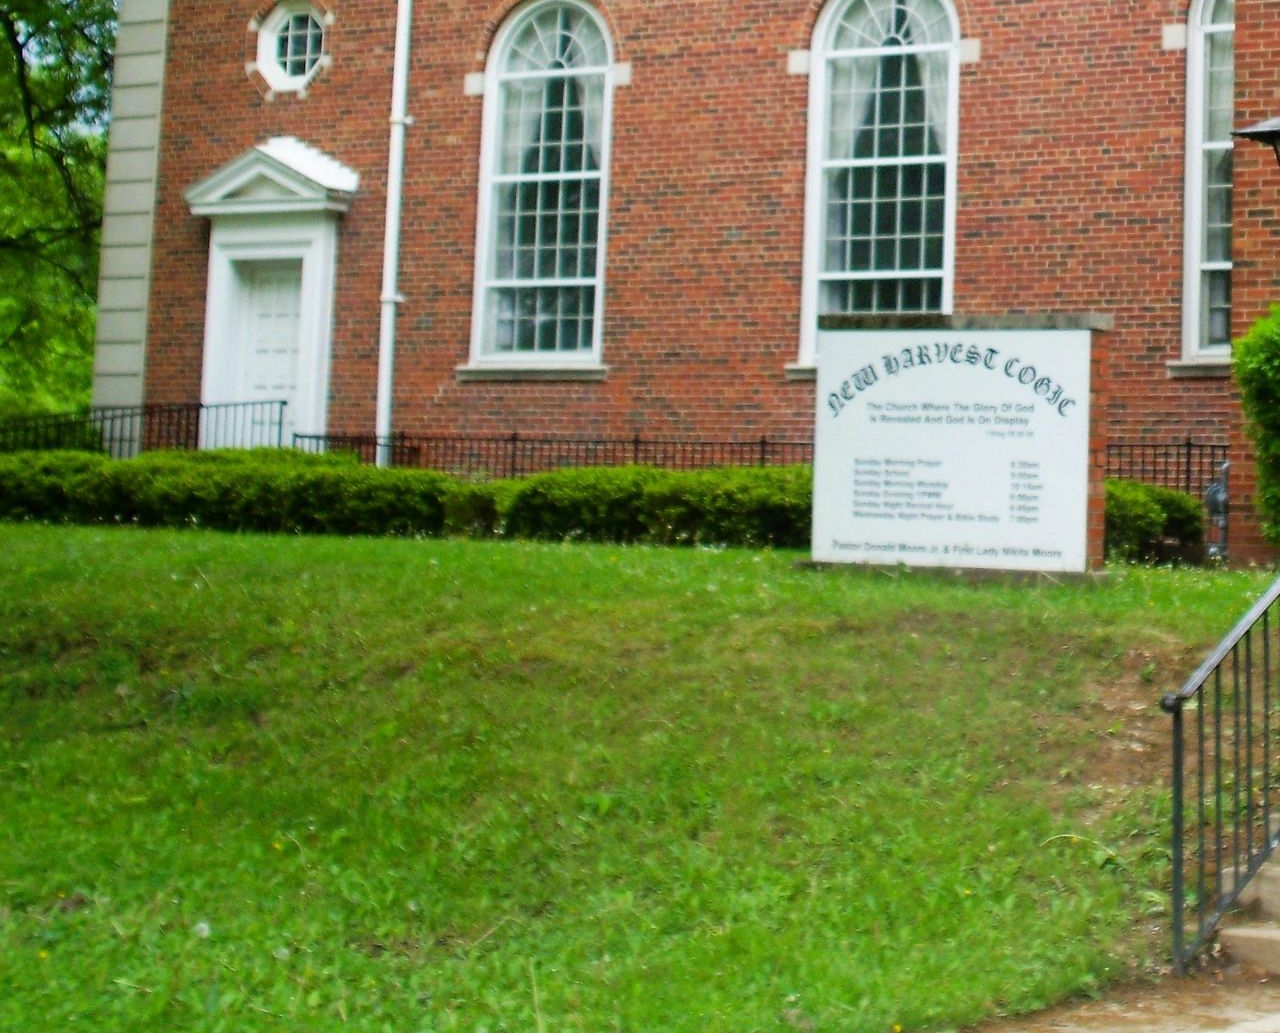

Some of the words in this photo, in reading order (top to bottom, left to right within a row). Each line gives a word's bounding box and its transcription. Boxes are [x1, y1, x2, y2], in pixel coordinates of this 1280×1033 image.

[828, 364, 878, 417] NEW
[882, 343, 1000, 376] HARVEST
[1004, 357, 1077, 417] COGIC
[867, 402, 883, 411] The
[886, 402, 918, 411] Church
[921, 402, 950, 411] Where
[954, 403, 969, 412] The
[973, 403, 997, 414] Glory
[1001, 403, 1012, 412] Of
[1015, 404, 1035, 413] God
[881, 415, 921, 424] Revealed
[924, 415, 943, 424] And
[946, 416, 965, 424] God
[978, 416, 991, 425] On
[994, 416, 1029, 426] Display
[832, 540, 861, 550] Pastor
[864, 542, 896, 552] Donald
[899, 543, 926, 552] Moore
[943, 544, 949, 554] &
[976, 546, 998, 557] Lady
[1032, 548, 1063, 559] Moore
